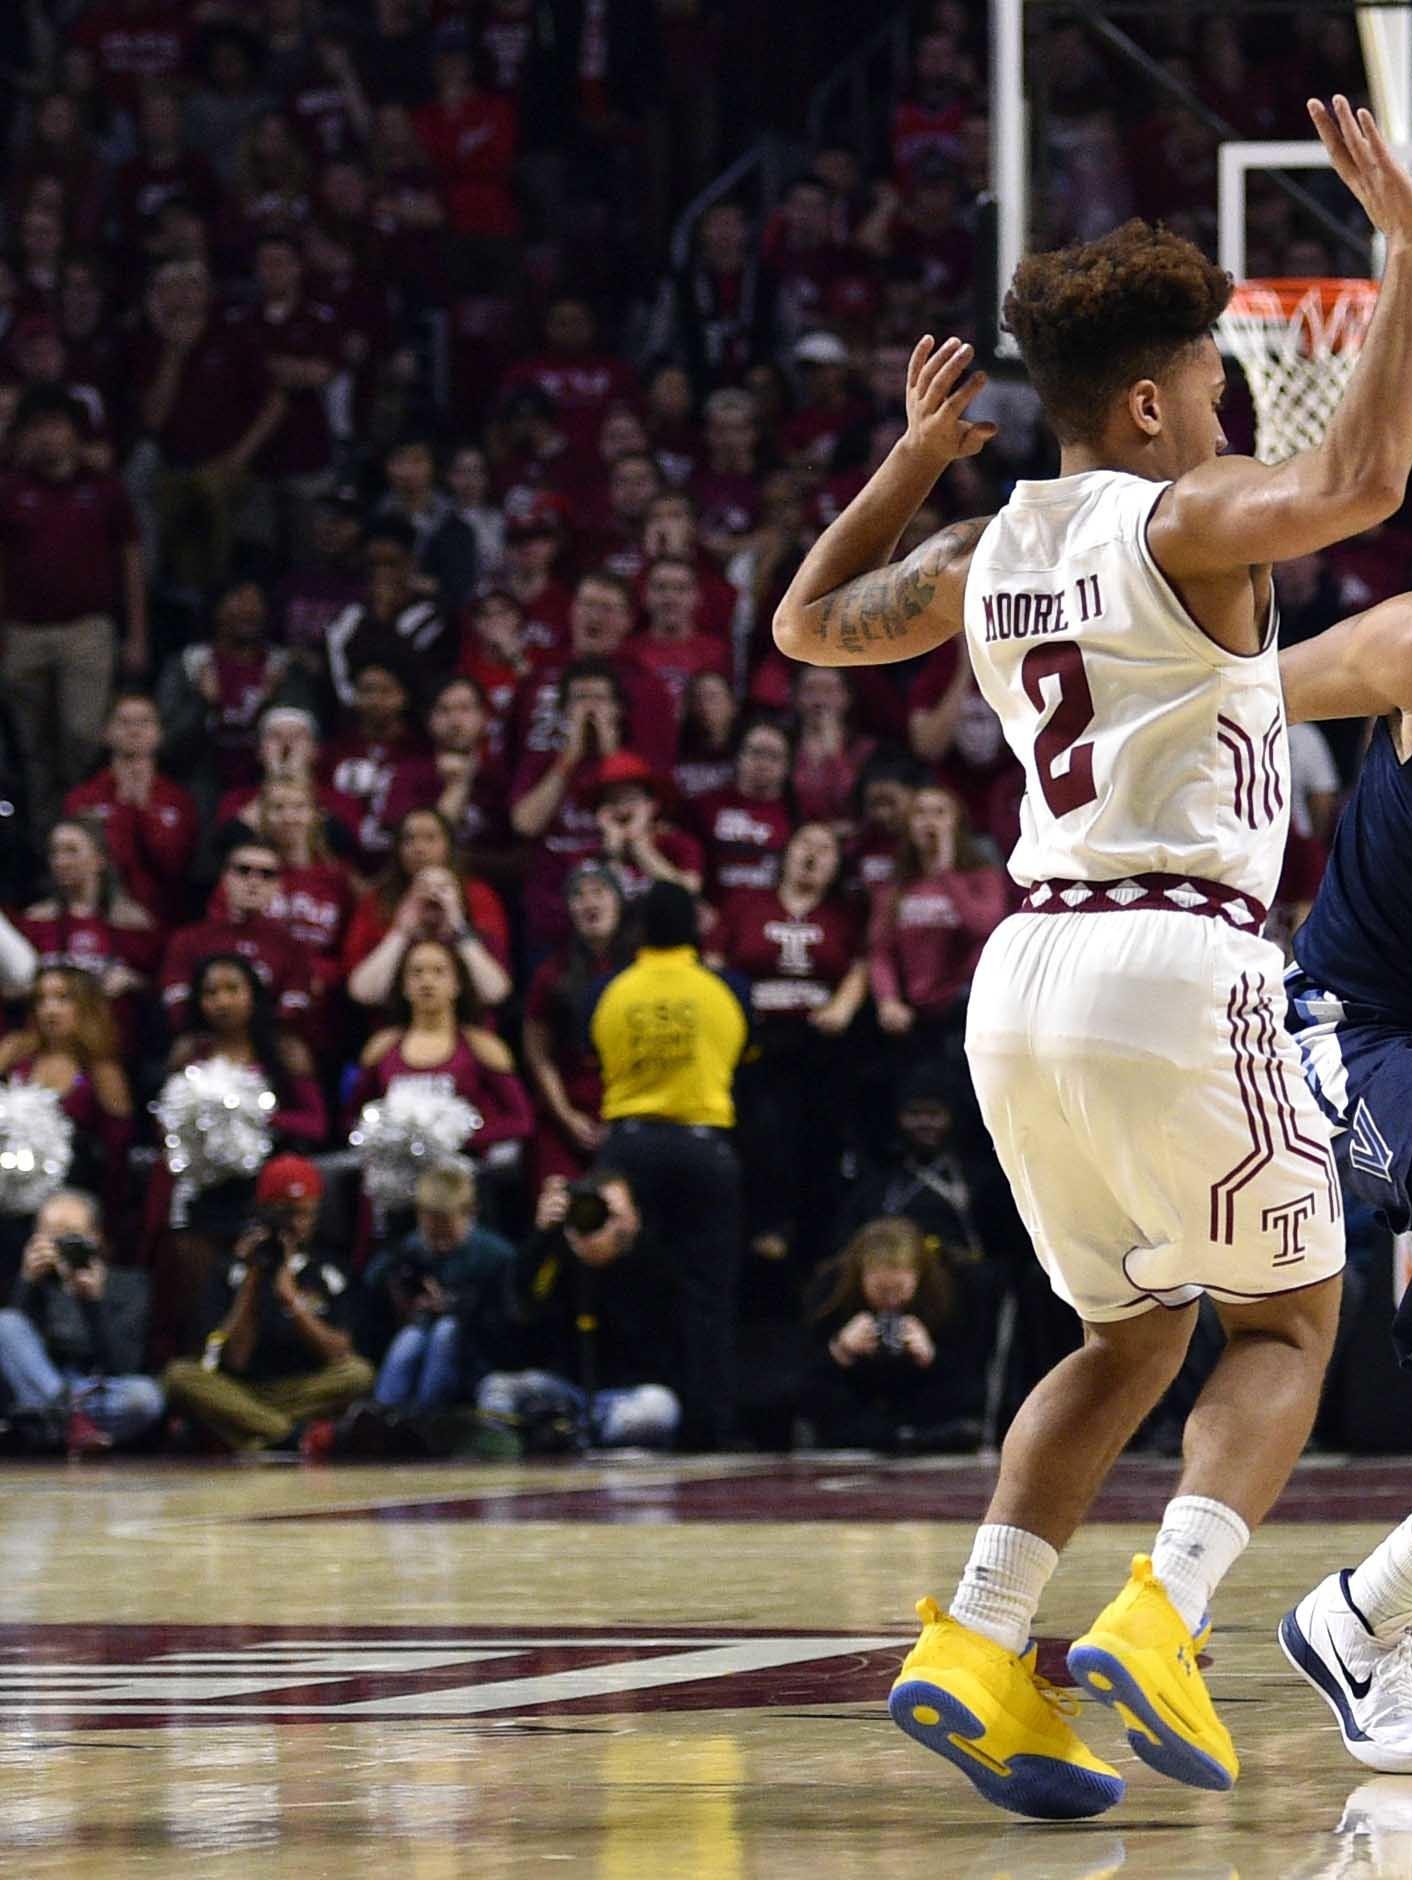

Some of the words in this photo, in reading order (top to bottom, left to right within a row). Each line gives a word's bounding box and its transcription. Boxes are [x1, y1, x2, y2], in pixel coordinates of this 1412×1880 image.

[982, 590, 1069, 642] MOORE
[1022, 640, 1098, 820] 2
[1262, 1192, 1315, 1267] T
